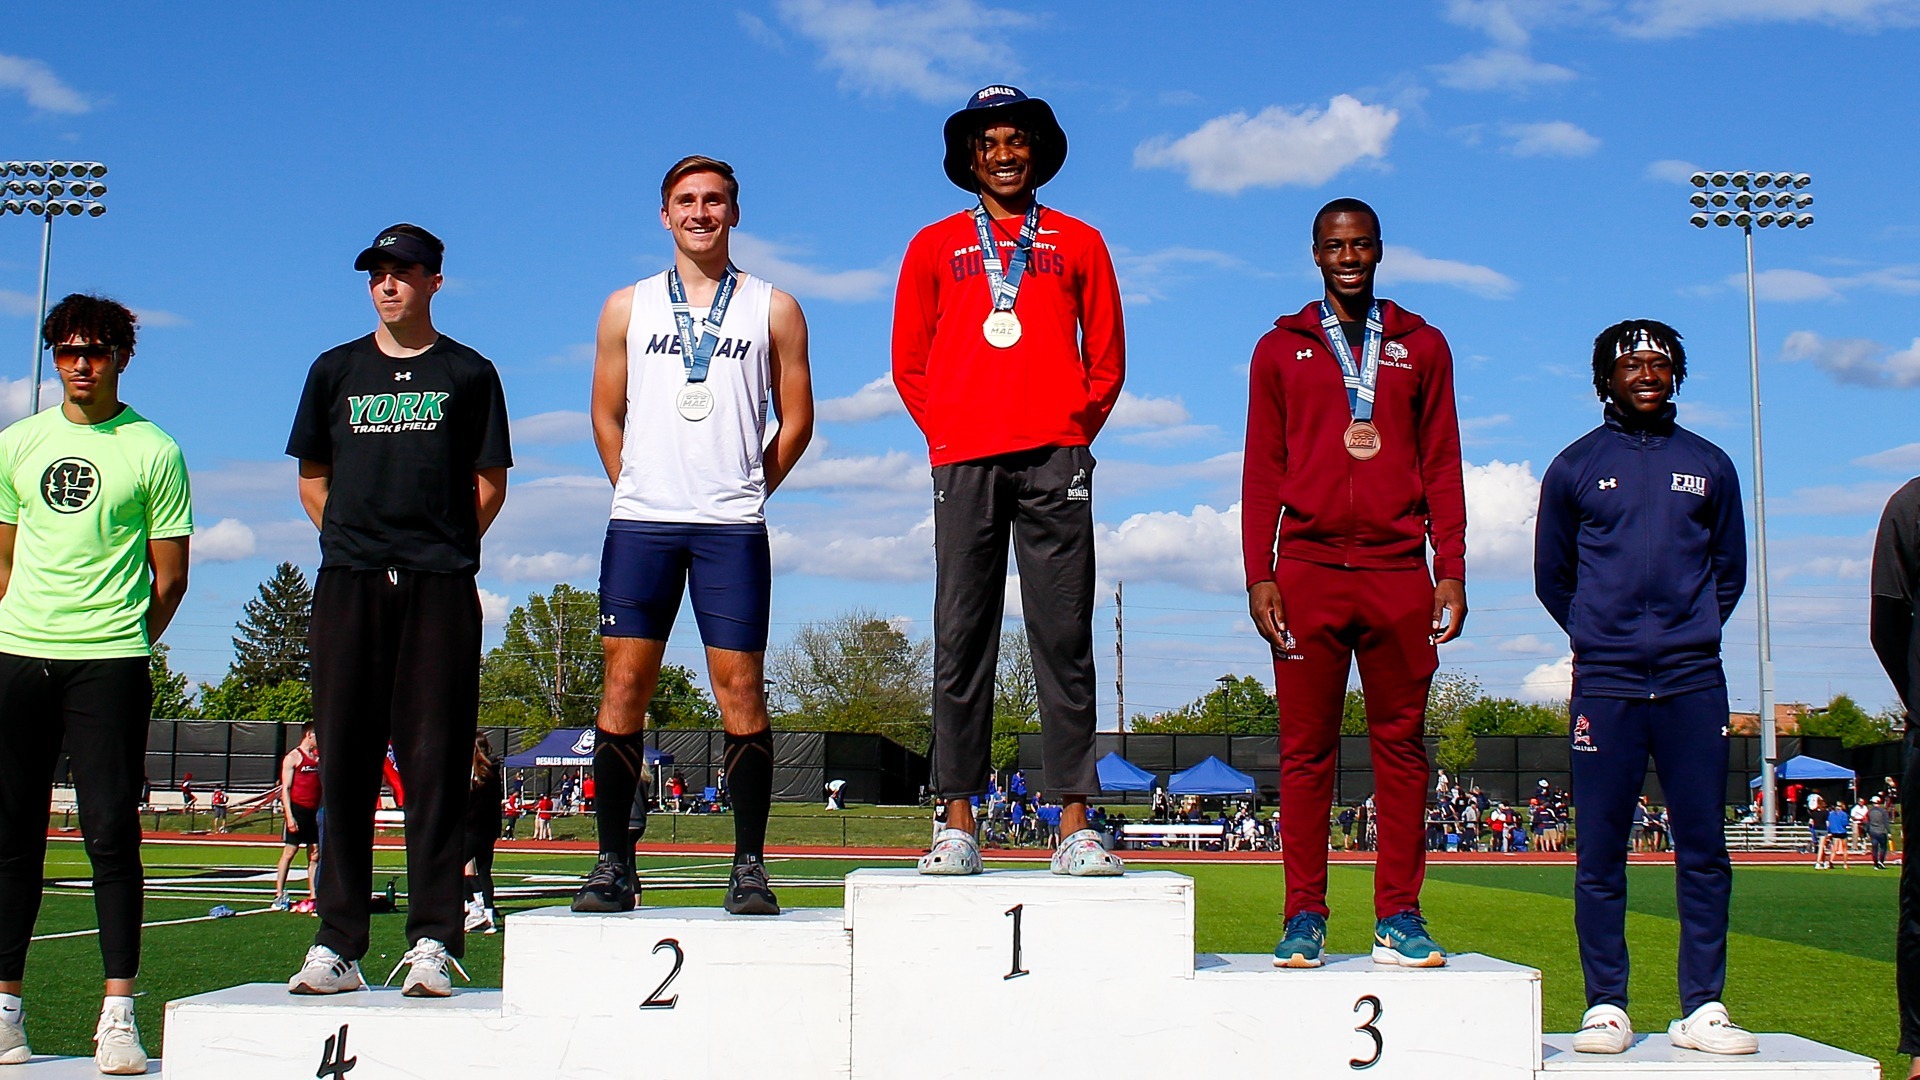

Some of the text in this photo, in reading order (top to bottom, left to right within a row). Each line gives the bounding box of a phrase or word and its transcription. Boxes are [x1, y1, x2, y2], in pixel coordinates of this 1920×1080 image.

[954, 248, 967, 257] DE
[347, 391, 450, 424] YORK
[352, 421, 437, 433] TRACK & FIELD
[1671, 472, 1706, 491] FDU
[535, 756, 562, 766] DESALES
[1003, 903, 1030, 981] 1
[639, 937, 684, 1010] 2
[1349, 994, 1383, 1071] 3
[316, 1023, 357, 1080] 4
